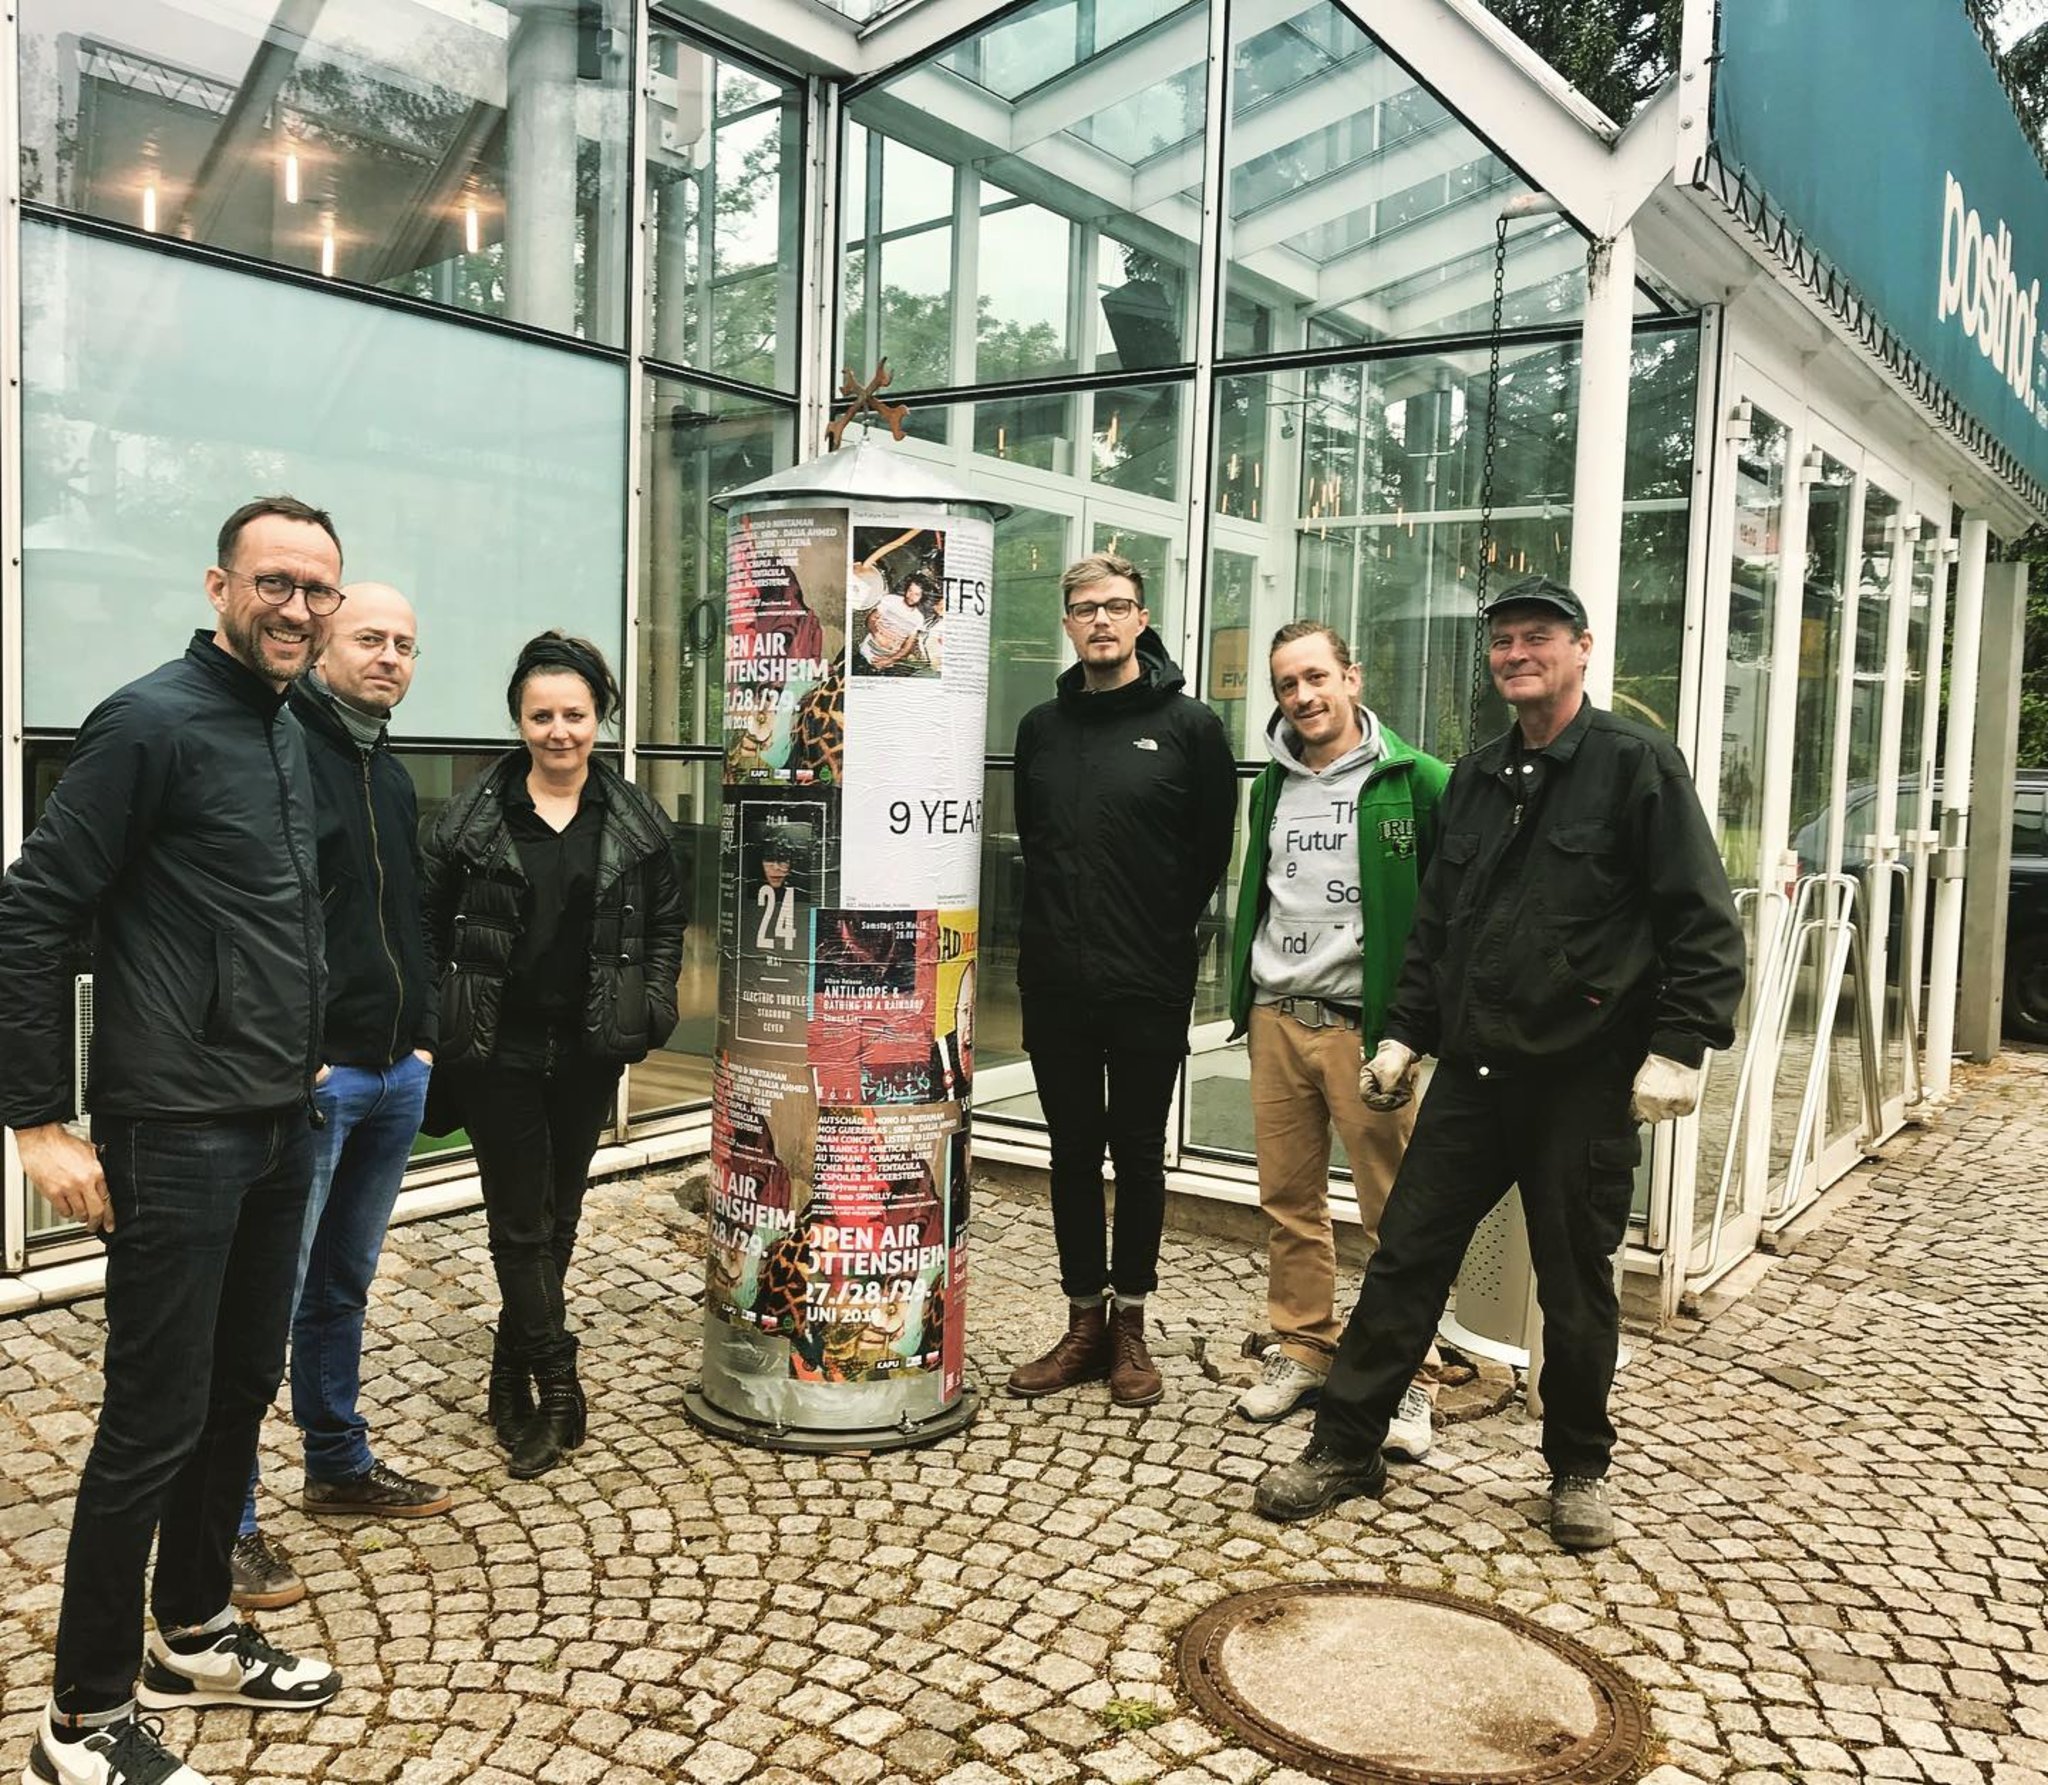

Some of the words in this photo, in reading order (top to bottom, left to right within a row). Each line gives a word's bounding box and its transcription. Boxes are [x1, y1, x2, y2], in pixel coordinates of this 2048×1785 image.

[942, 577, 985, 616] TFS
[752, 633, 787, 656] AIR
[889, 801, 911, 834] 9
[1286, 830, 1348, 852] Futur
[1286, 861, 1297, 878] e
[1326, 880, 1361, 903] So
[756, 885, 797, 951] 24
[823, 986, 888, 999] ANTILOOPE
[892, 987, 900, 999] &
[863, 1001, 873, 1010] IN
[875, 1001, 881, 1010] A
[780, 1082, 809, 1093] AHMED
[912, 1133, 922, 1141] TO
[813, 1163, 843, 1172] TCHER
[878, 1161, 921, 1172] TENTACULA
[727, 1171, 757, 1201] AIR
[880, 1223, 920, 1249] AIR
[876, 1361, 900, 1369] KAPU
